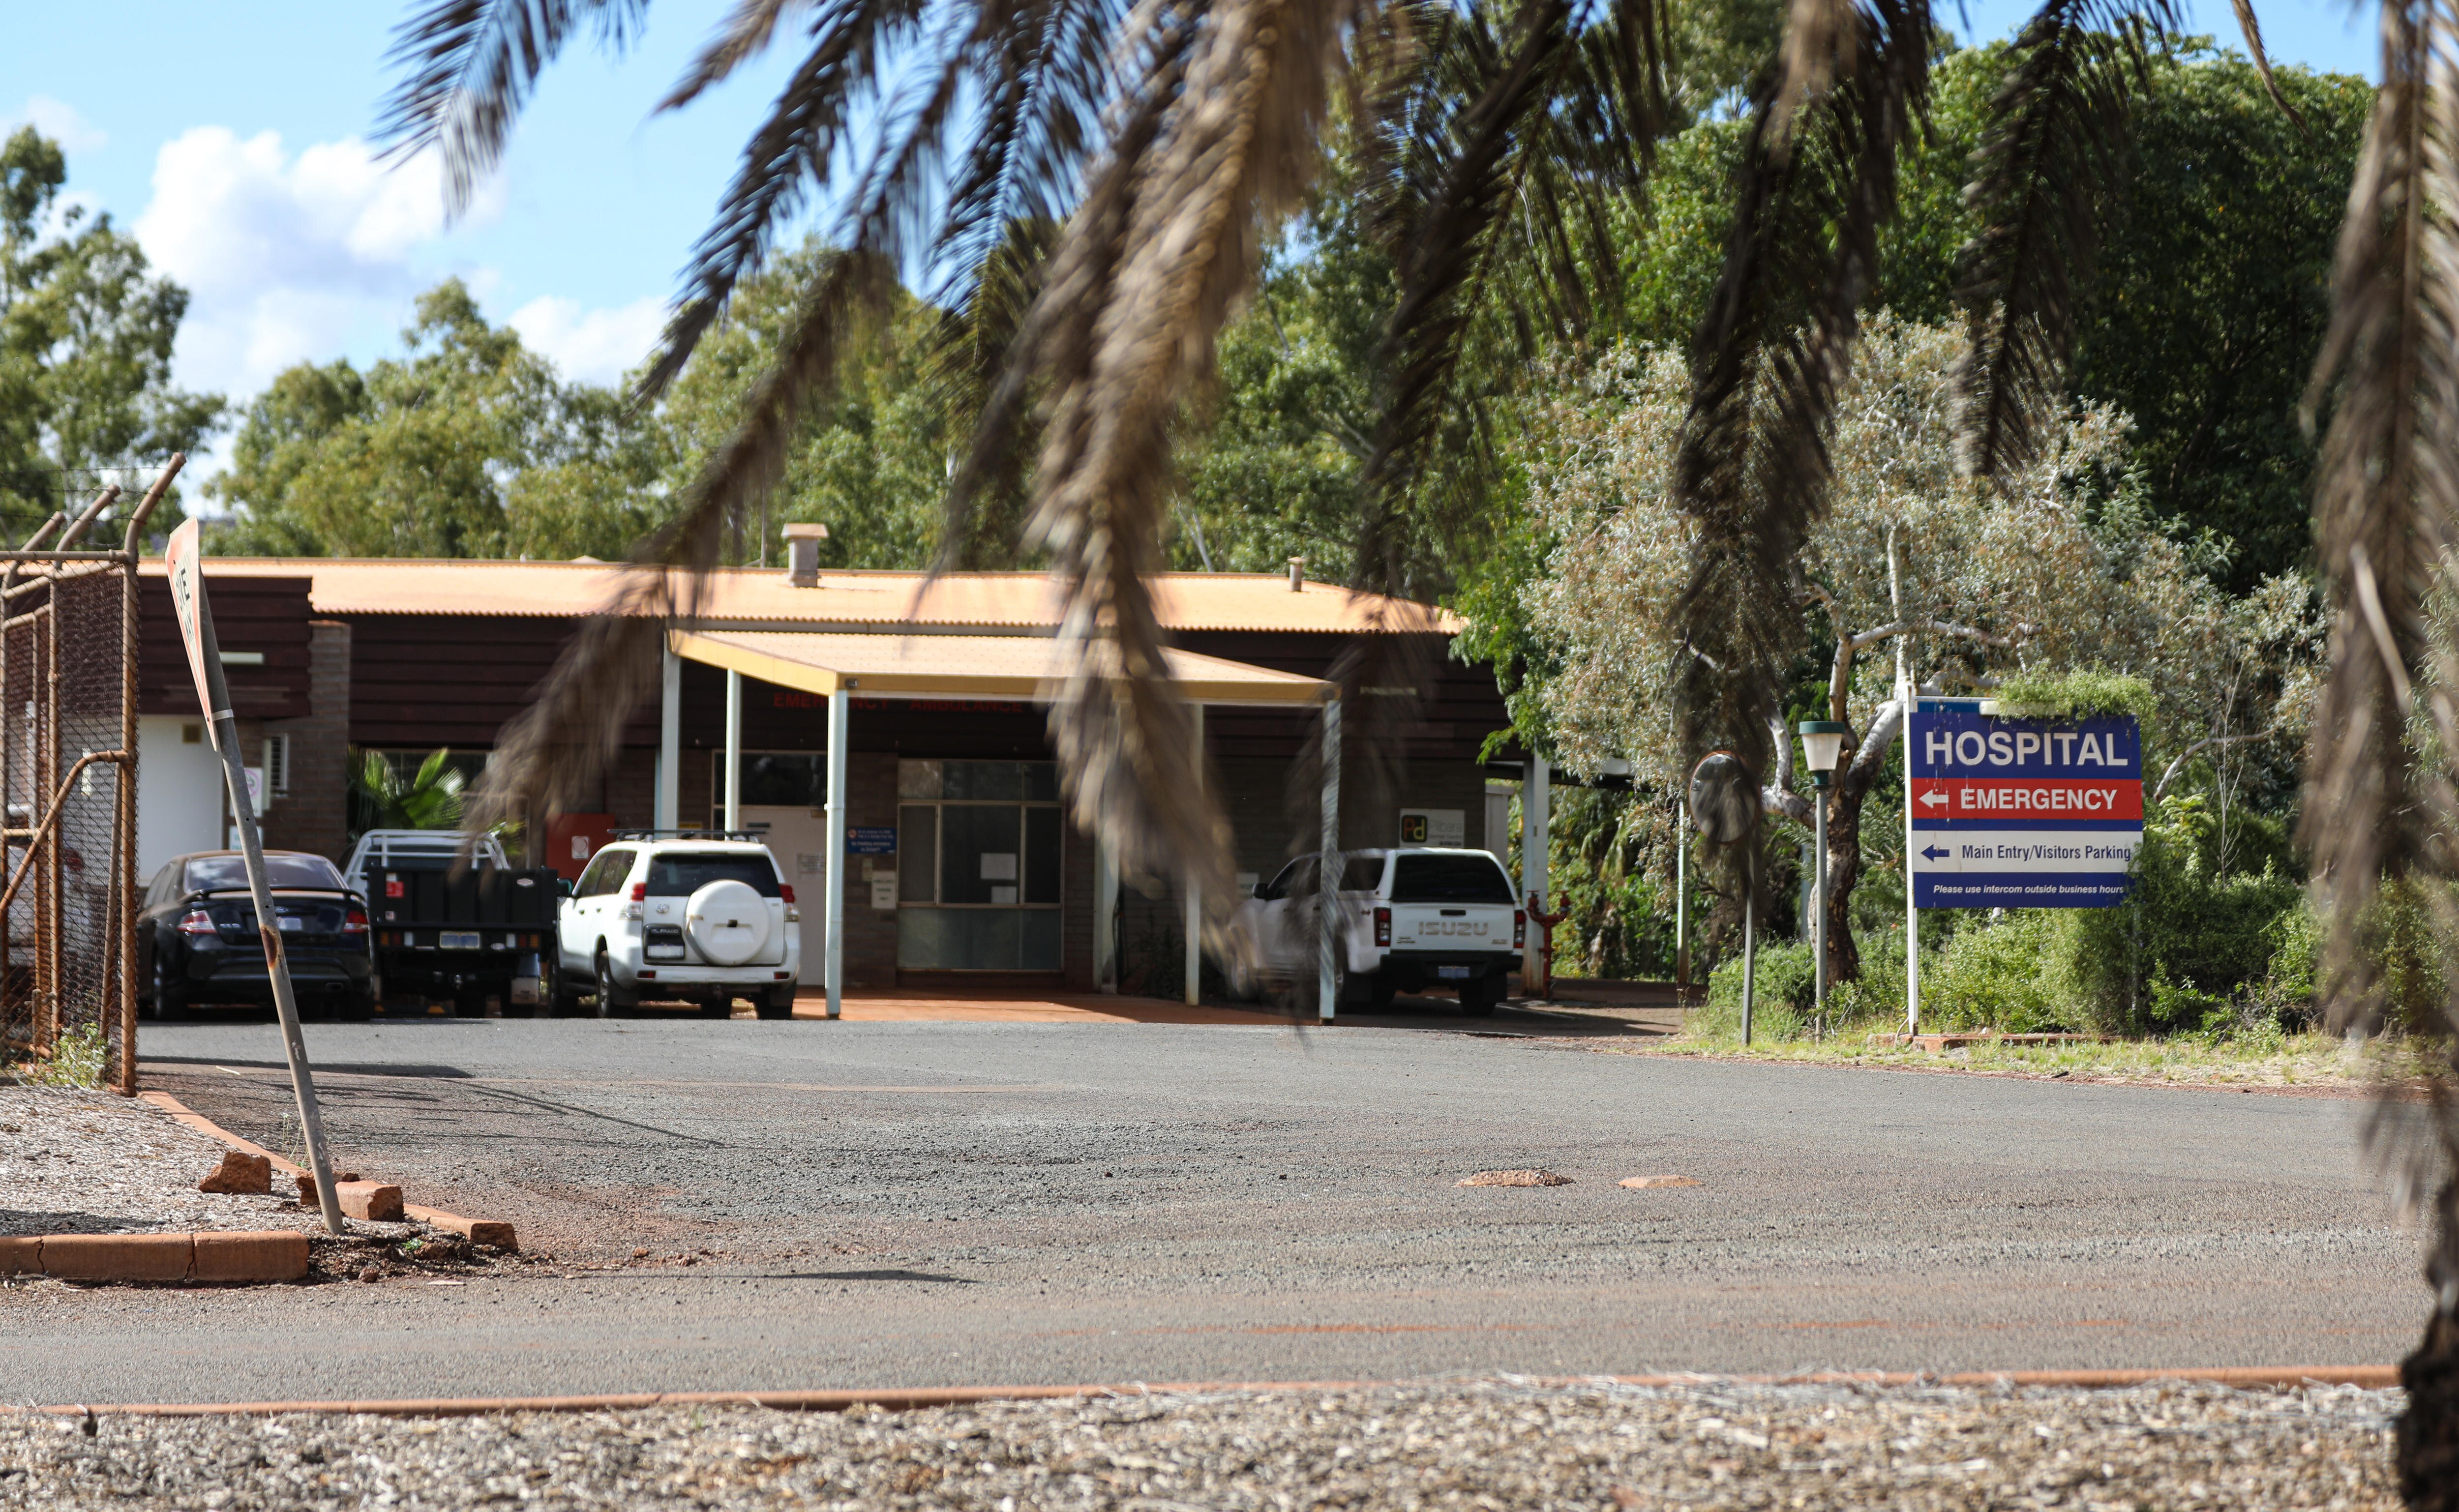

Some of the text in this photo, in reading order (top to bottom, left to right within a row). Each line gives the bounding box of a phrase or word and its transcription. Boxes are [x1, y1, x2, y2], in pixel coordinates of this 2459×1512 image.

[774, 692, 1022, 712] EMERNCY AMBULANCE
[1925, 731, 2129, 766] HOSPITAL
[1960, 788, 2117, 810] EMERGENCY
[1429, 820, 1462, 832] Pilbara
[1962, 845, 2131, 861] Main Entry/Visitors Parking
[1933, 885, 1963, 894] Please
[1983, 885, 2022, 894] intercom
[2025, 885, 2057, 894] outside
[2059, 885, 2098, 894] business
[2099, 885, 2124, 893] hours
[1418, 921, 1488, 936] ISUZU
